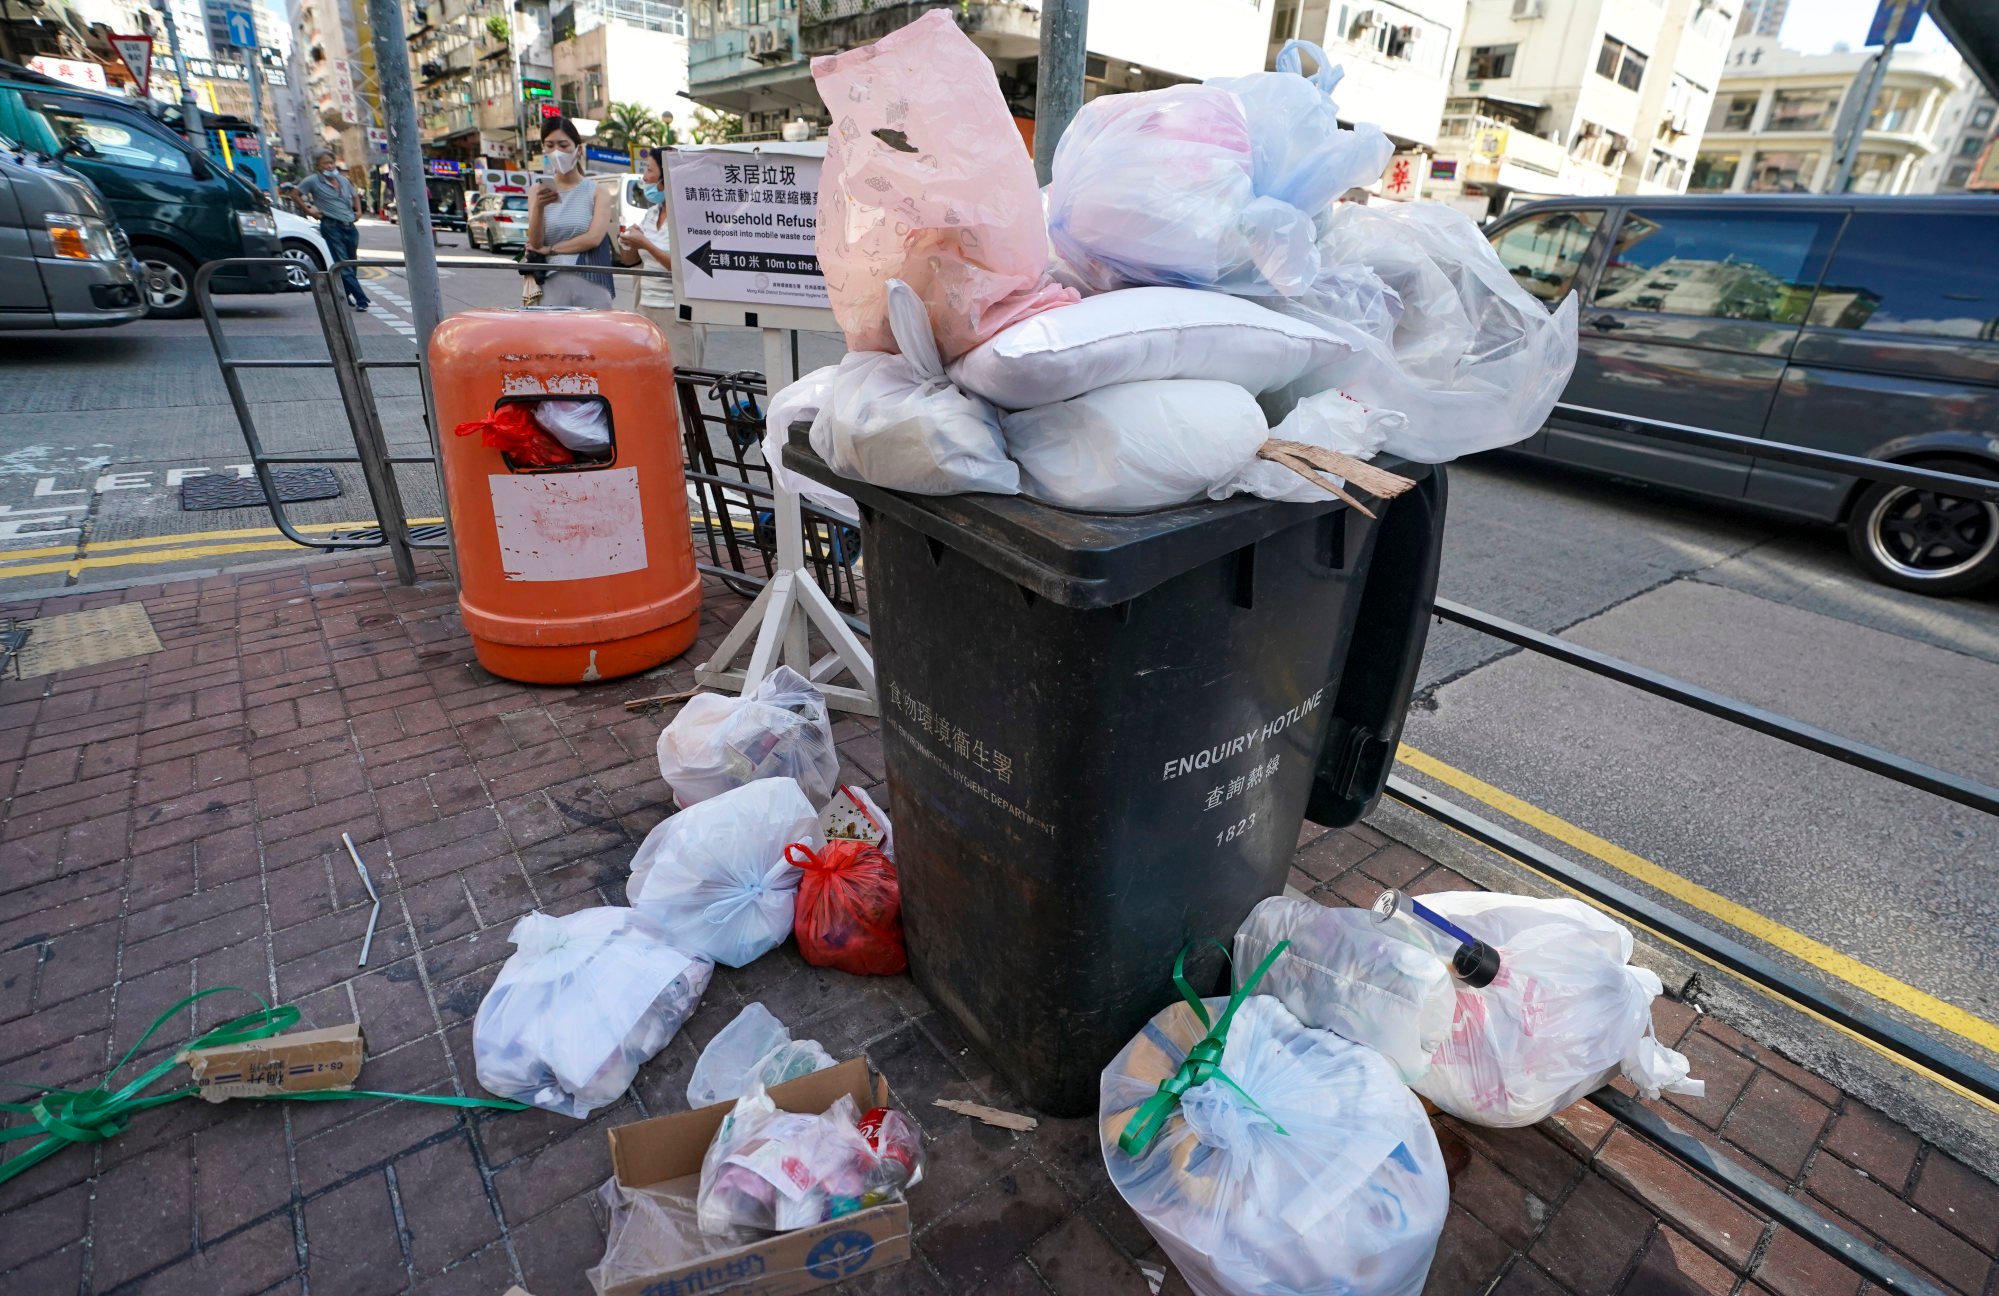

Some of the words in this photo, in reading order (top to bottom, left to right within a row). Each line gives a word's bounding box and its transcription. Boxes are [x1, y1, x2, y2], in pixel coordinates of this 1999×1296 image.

[724, 164, 796, 186] 家居垃圾
[705, 211, 773, 226] Household
[687, 227, 712, 237] Please
[713, 229, 738, 239] deposit
[739, 230, 753, 238] into
[754, 231, 778, 240] mobile
[779, 233, 801, 241] waste
[708, 253, 730, 268] 左轉
[733, 256, 746, 268] 10
[748, 256, 760, 269] 米
[766, 258, 785, 270] 10m
[786, 260, 796, 270] to
[798, 261, 813, 271] the
[1162, 728, 1258, 781] ENQUIRY
[1260, 688, 1324, 743] HOTLINE
[1203, 753, 1281, 812] 查詢熱線
[953, 768, 989, 801] HYGIENE
[990, 792, 1057, 837] DEPARTMENT
[1216, 812, 1257, 848] 1823
